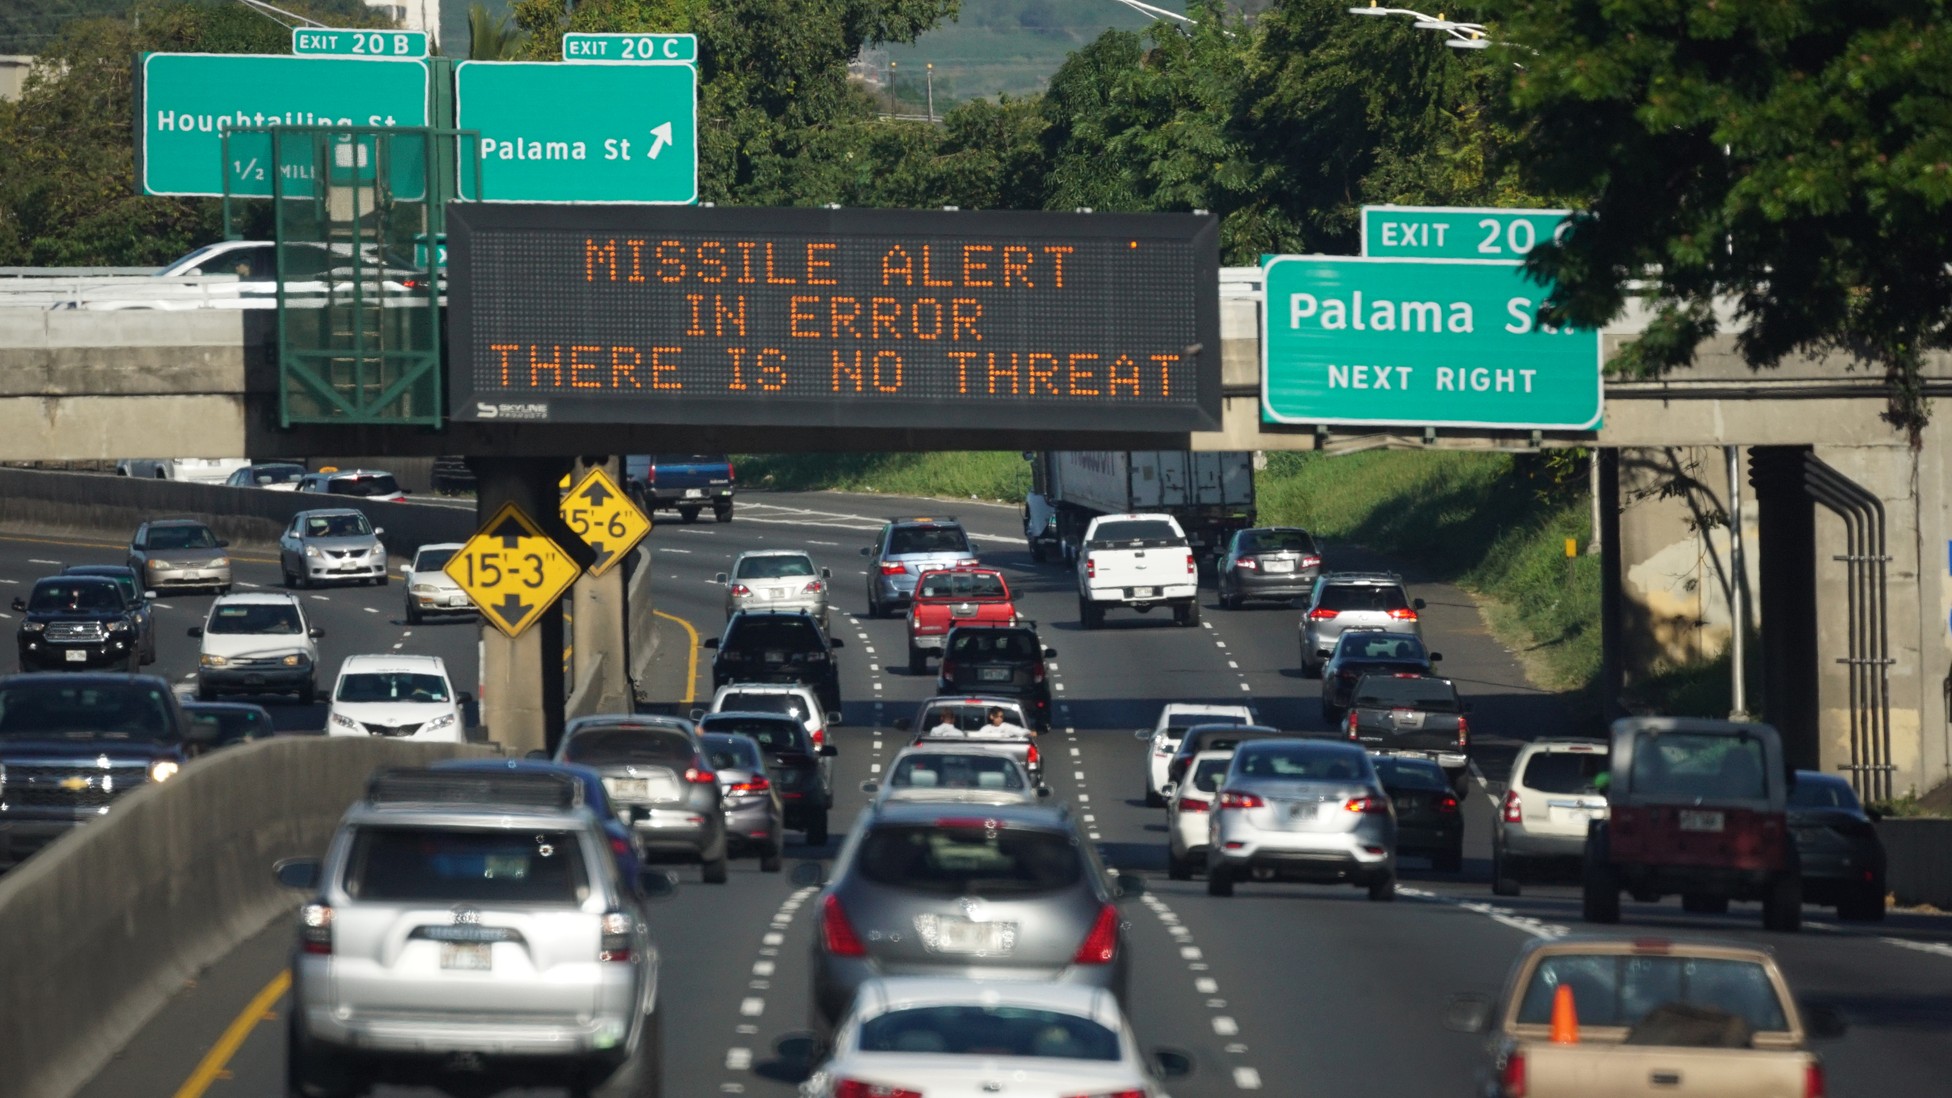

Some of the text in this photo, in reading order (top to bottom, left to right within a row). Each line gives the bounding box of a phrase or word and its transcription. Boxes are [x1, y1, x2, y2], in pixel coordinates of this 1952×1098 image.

[299, 34, 409, 54] EXIT 20 B
[569, 38, 679, 58] EXIT 20 C
[157, 109, 397, 142] Houghtailing St
[480, 137, 632, 160] Palama St
[1381, 222, 1450, 247] EXIT
[1477, 218, 1536, 254] 20
[586, 238, 1074, 289] MISSILE ALERT
[687, 293, 983, 342] IN ERROR
[1290, 290, 1474, 333] Palama
[490, 343, 1180, 397] THERE IS NO THREAT
[1327, 365, 1537, 393] NEXT RIGHT
